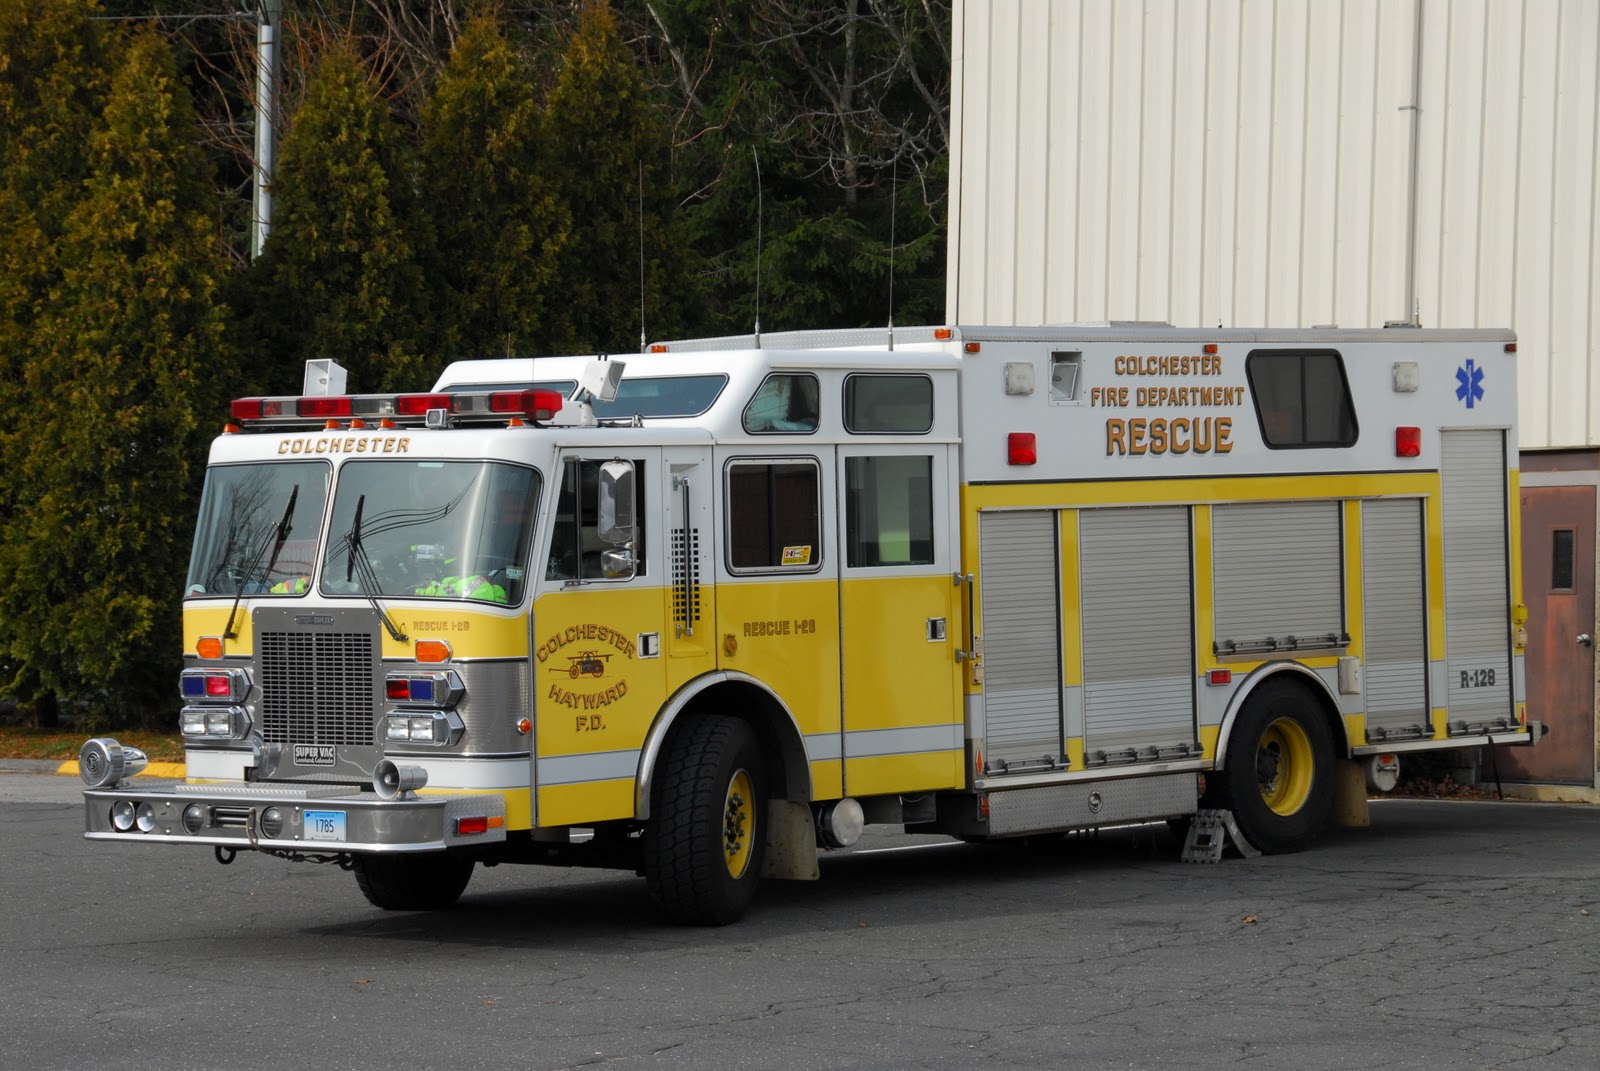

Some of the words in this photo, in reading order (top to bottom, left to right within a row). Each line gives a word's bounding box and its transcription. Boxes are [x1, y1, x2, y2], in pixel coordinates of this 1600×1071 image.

[1115, 356, 1222, 375] COLCHESTER
[1091, 387, 1129, 407] FIRE
[1137, 387, 1245, 406] DEPARTMENT
[278, 437, 410, 454] COLCHESTER
[1106, 417, 1234, 456] RESCUE
[413, 621, 448, 631] RESCUE
[743, 620, 790, 637] RESCUE
[536, 624, 637, 663] COLCHESTER
[1460, 668, 1496, 689] R-128
[548, 679, 629, 710] HAYWARD
[576, 714, 607, 732] F.D.
[296, 746, 318, 757] SUPER
[319, 747, 333, 758] VAC
[315, 819, 334, 833] 1785
